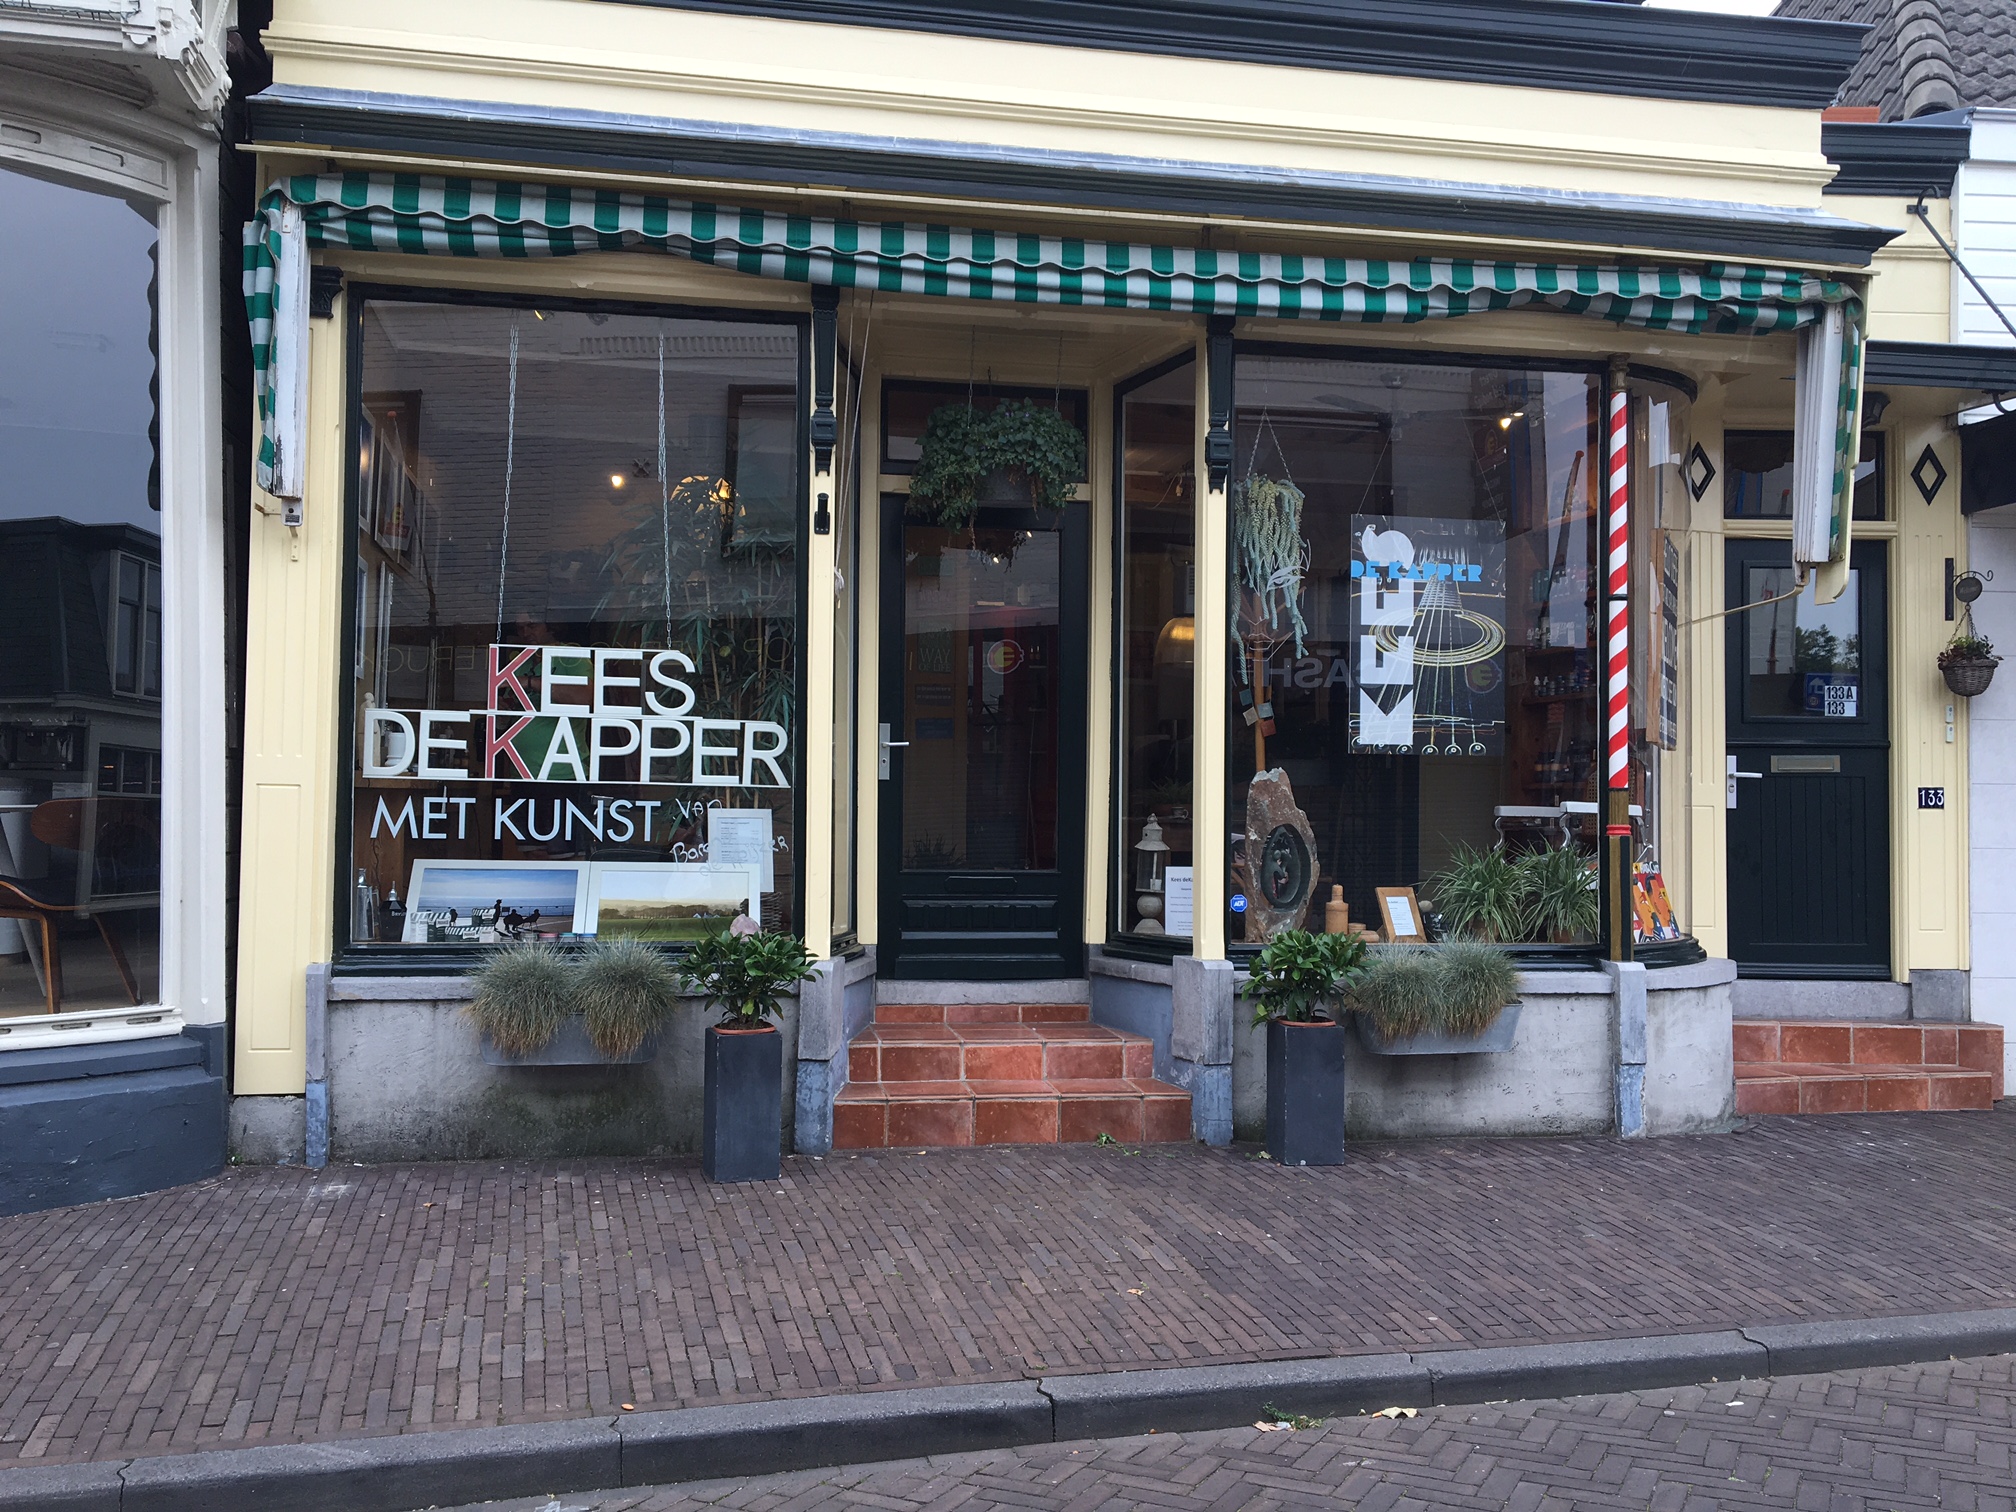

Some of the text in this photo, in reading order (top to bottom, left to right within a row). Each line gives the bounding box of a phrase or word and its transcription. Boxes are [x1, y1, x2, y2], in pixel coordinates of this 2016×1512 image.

[1351, 559, 1483, 583] DE KAPPER
[919, 647, 951, 664] WAY
[488, 643, 697, 717] KEES
[1826, 685, 1854, 700] 133A
[1826, 701, 1846, 715] 133
[362, 708, 791, 788] DE KAPPER
[1918, 789, 1944, 806] 133
[370, 795, 662, 843] MET KUNST
